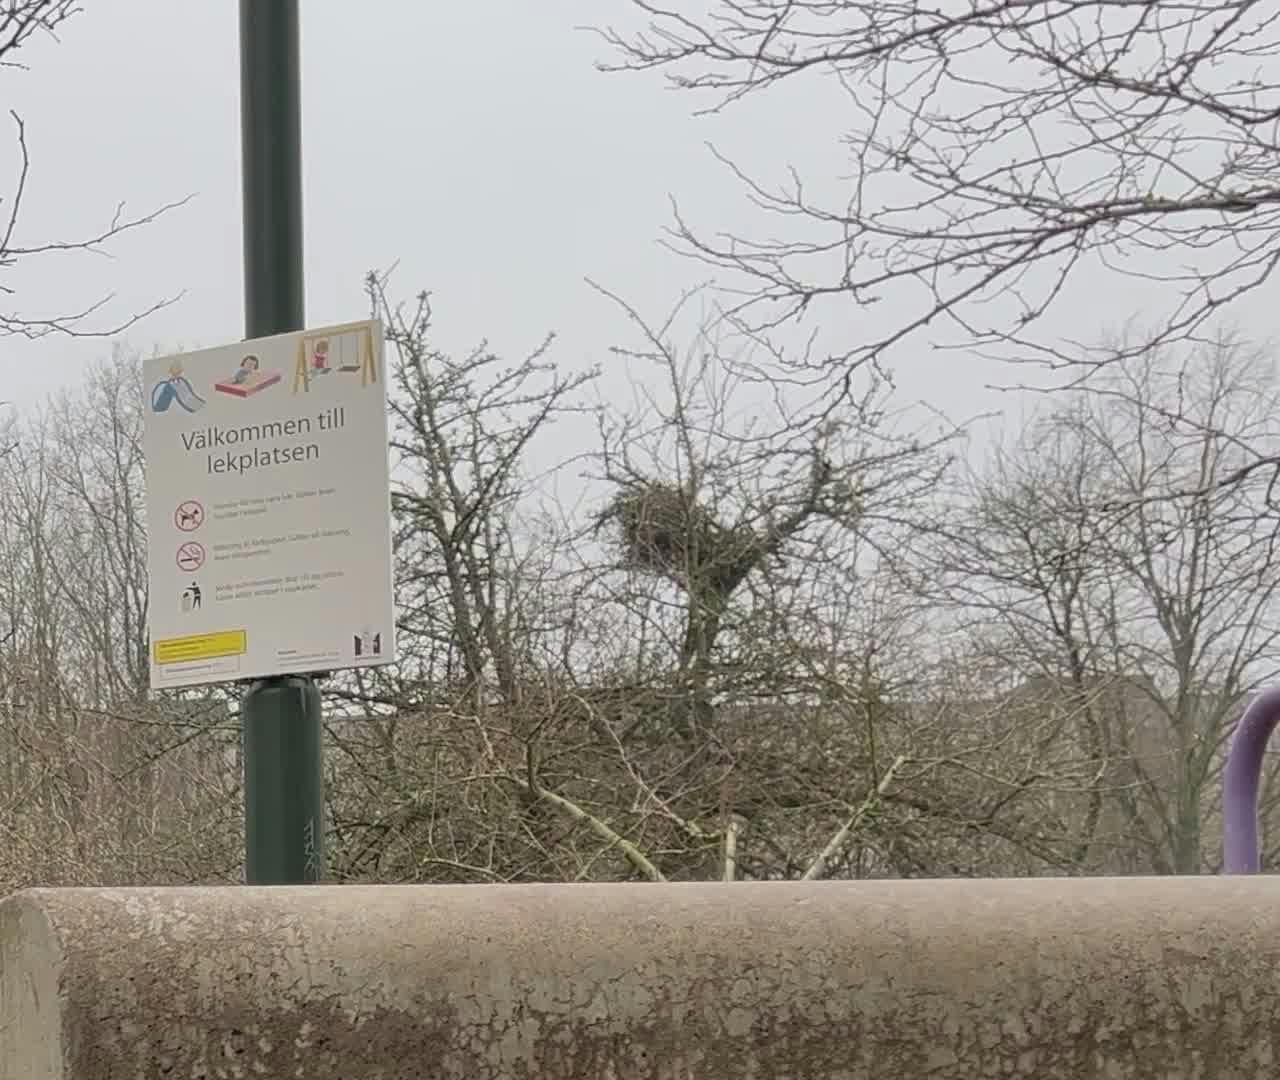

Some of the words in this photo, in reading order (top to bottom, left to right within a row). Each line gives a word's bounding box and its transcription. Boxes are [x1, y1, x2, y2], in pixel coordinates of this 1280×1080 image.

[181, 418, 311, 451] Välkommen
[317, 407, 345, 431] till
[207, 444, 319, 475] lekplatsen
